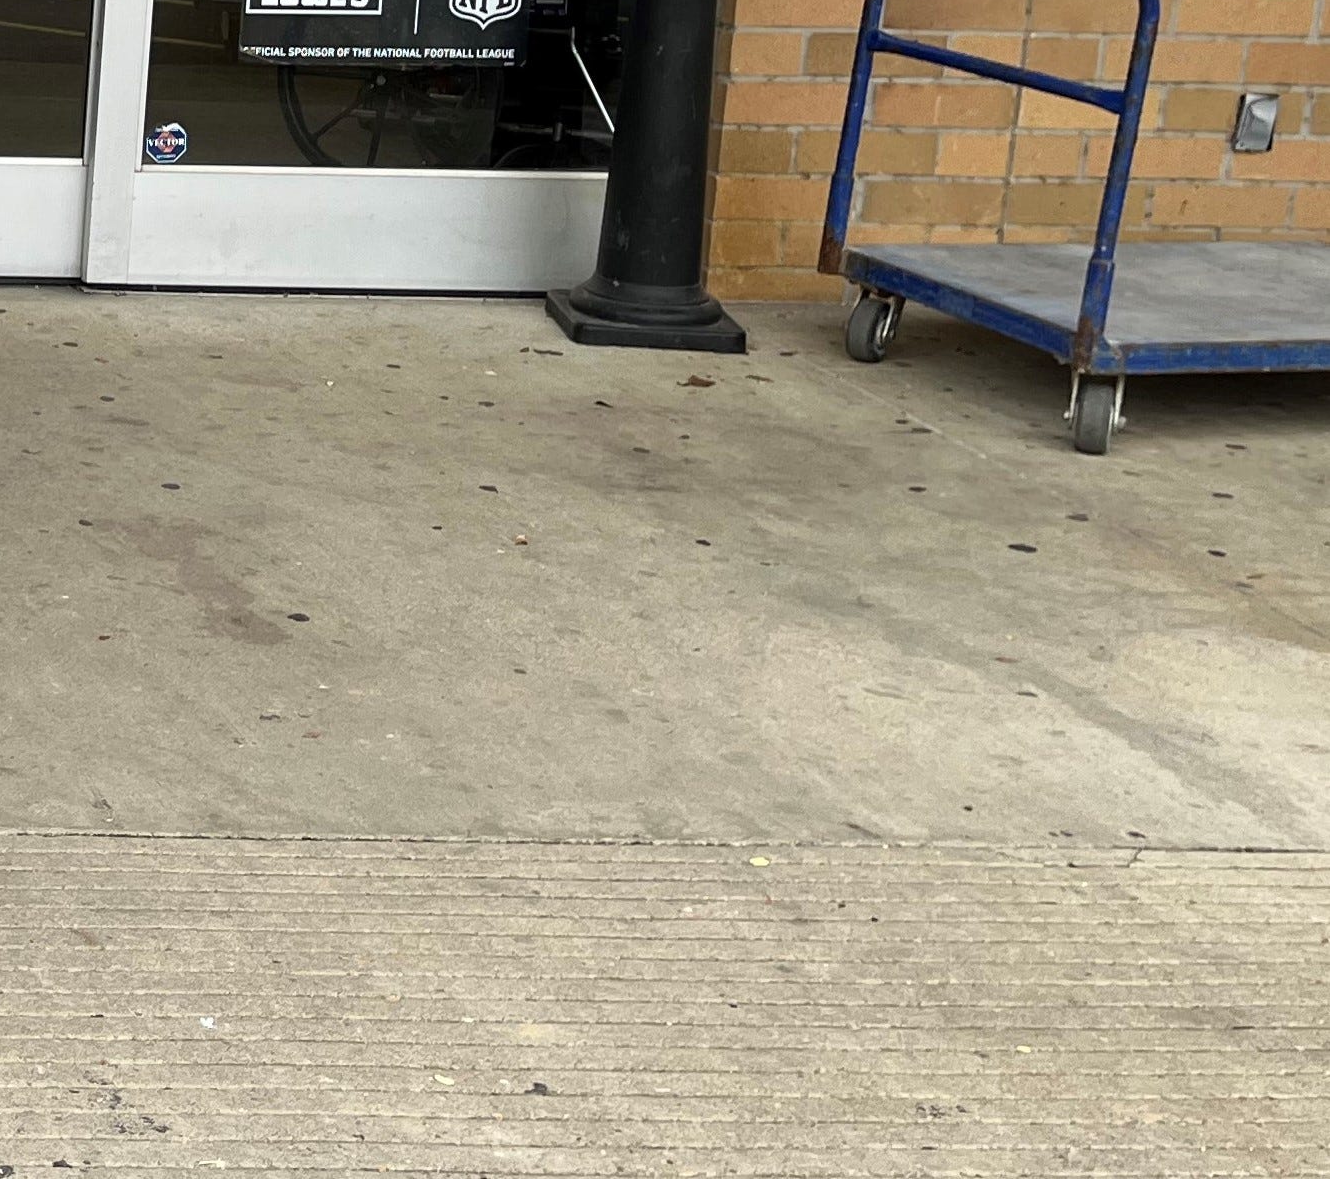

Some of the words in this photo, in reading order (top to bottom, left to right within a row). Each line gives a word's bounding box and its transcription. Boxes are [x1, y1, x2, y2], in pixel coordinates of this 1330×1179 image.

[240, 46, 286, 57] FICIAL
[288, 46, 335, 57] SPONSOR
[336, 47, 350, 57] OF
[352, 47, 372, 58] THE
[374, 47, 422, 58] NATIONAL
[424, 48, 474, 59] FOOTBALL
[476, 48, 515, 59] LEAGUE
[148, 138, 185, 147] VECTOR
